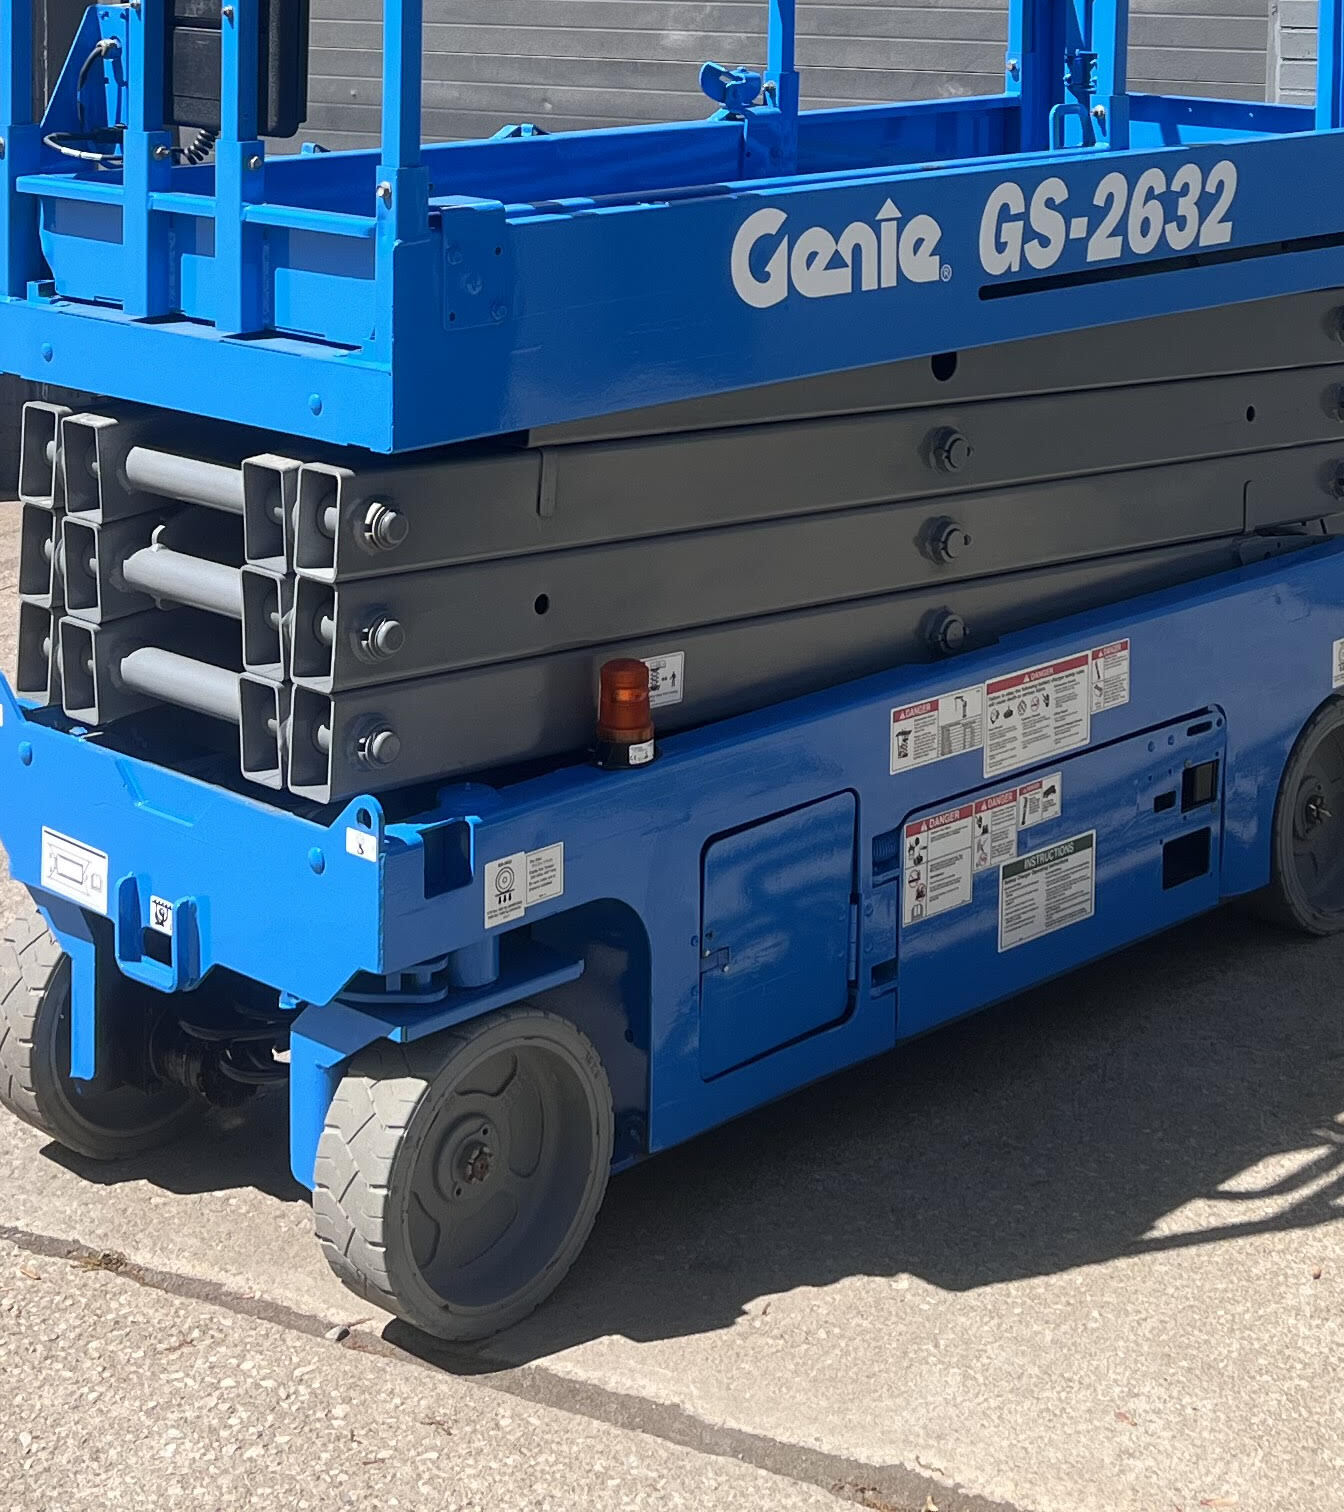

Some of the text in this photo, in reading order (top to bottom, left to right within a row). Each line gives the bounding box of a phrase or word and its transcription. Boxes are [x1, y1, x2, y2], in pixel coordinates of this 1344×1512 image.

[730, 159, 1238, 309] Genie GS-2632
[987, 792, 1014, 809] DANGER
[928, 809, 960, 829] DANGER
[1024, 841, 1075, 869] INSTRUCTIONS
